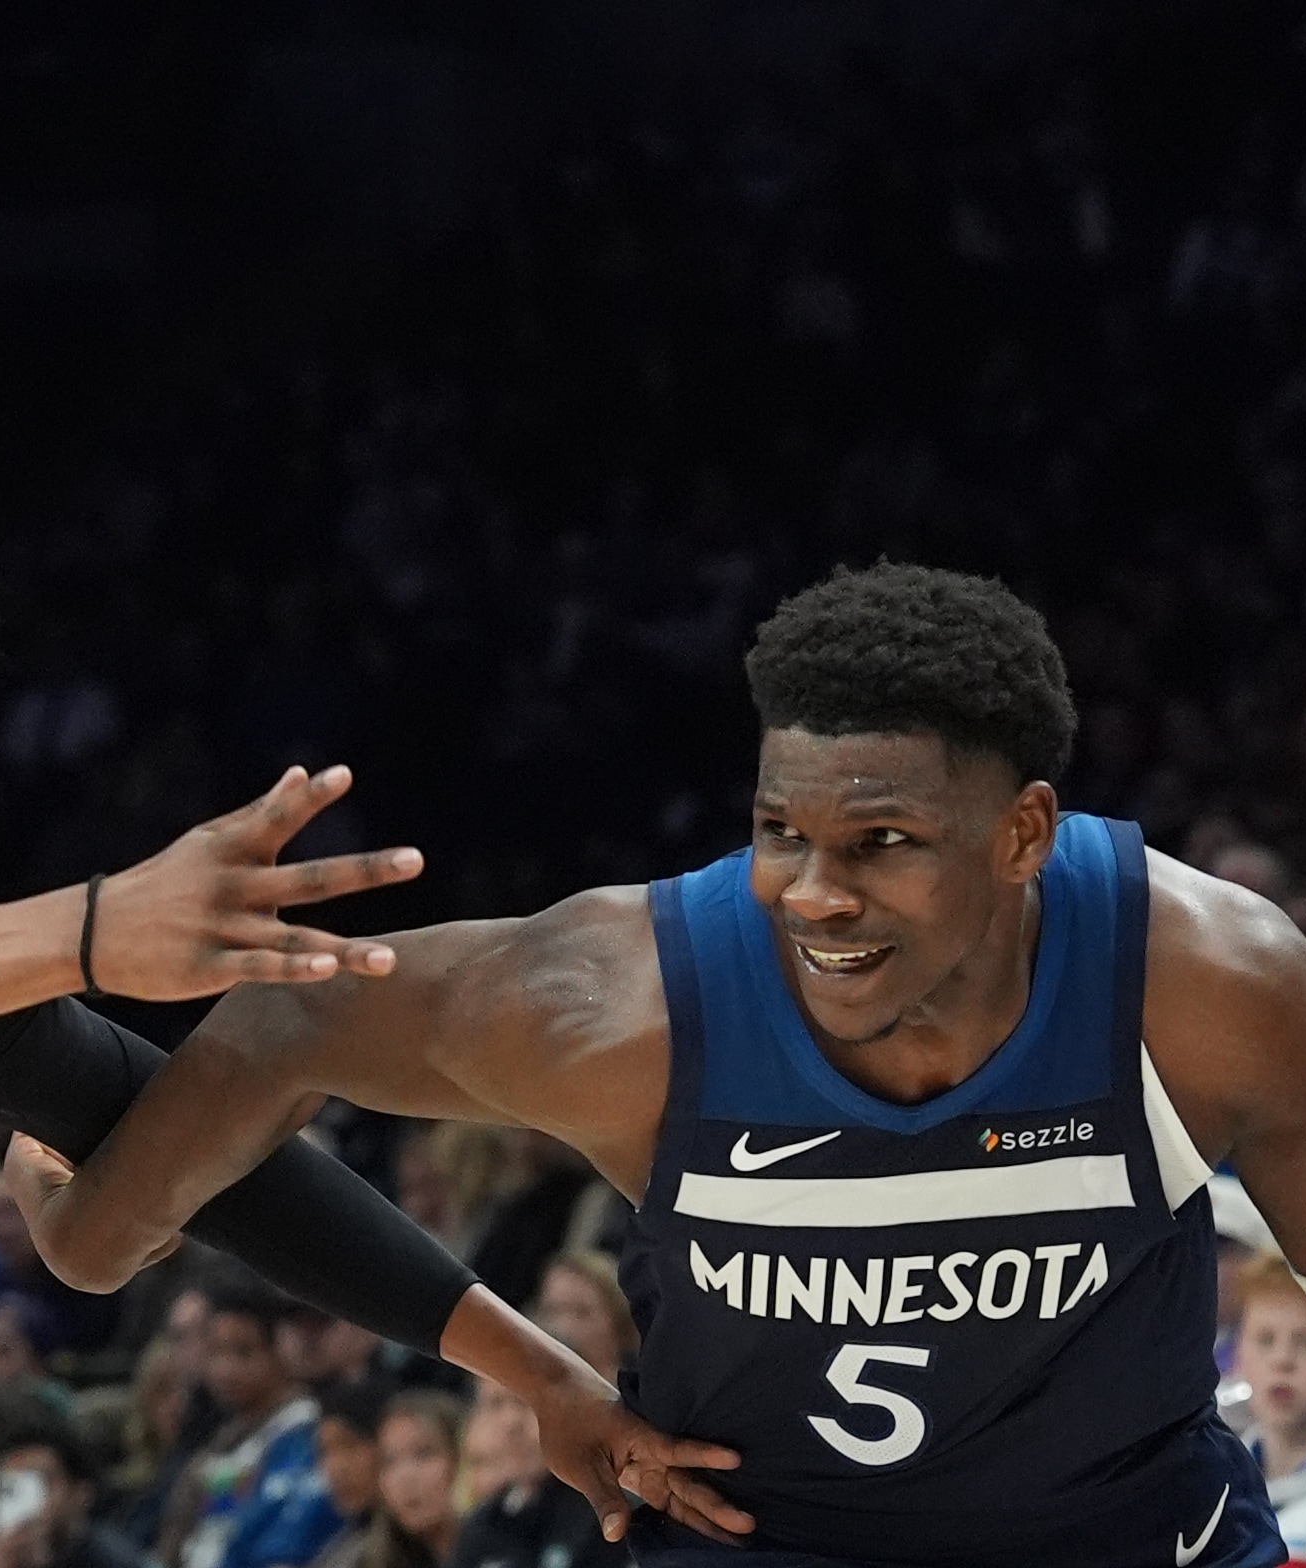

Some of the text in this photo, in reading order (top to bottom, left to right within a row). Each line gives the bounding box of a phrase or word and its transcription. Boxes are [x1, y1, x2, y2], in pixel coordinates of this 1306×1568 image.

[1000, 1117, 1095, 1151] sezzle
[689, 1238, 1110, 1326] MINNESOTA
[806, 1342, 930, 1467] 5
